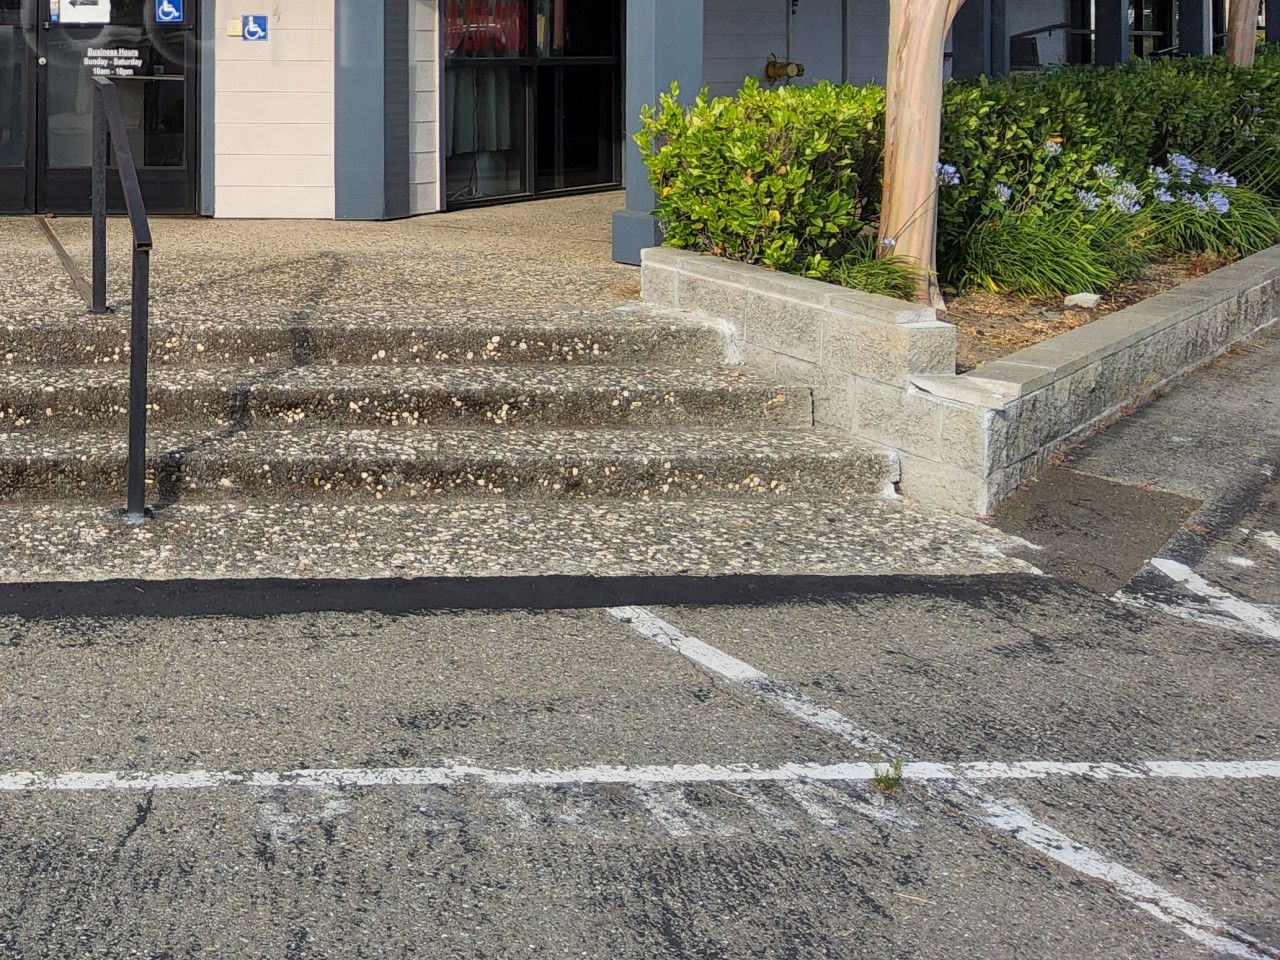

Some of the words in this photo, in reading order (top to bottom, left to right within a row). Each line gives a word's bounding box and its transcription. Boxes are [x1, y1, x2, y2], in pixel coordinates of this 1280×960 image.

[87, 48, 118, 56] Business
[118, 48, 139, 56] Hours
[83, 57, 108, 66] Sunday
[113, 57, 142, 67] Saturday
[92, 67, 111, 75] 10am
